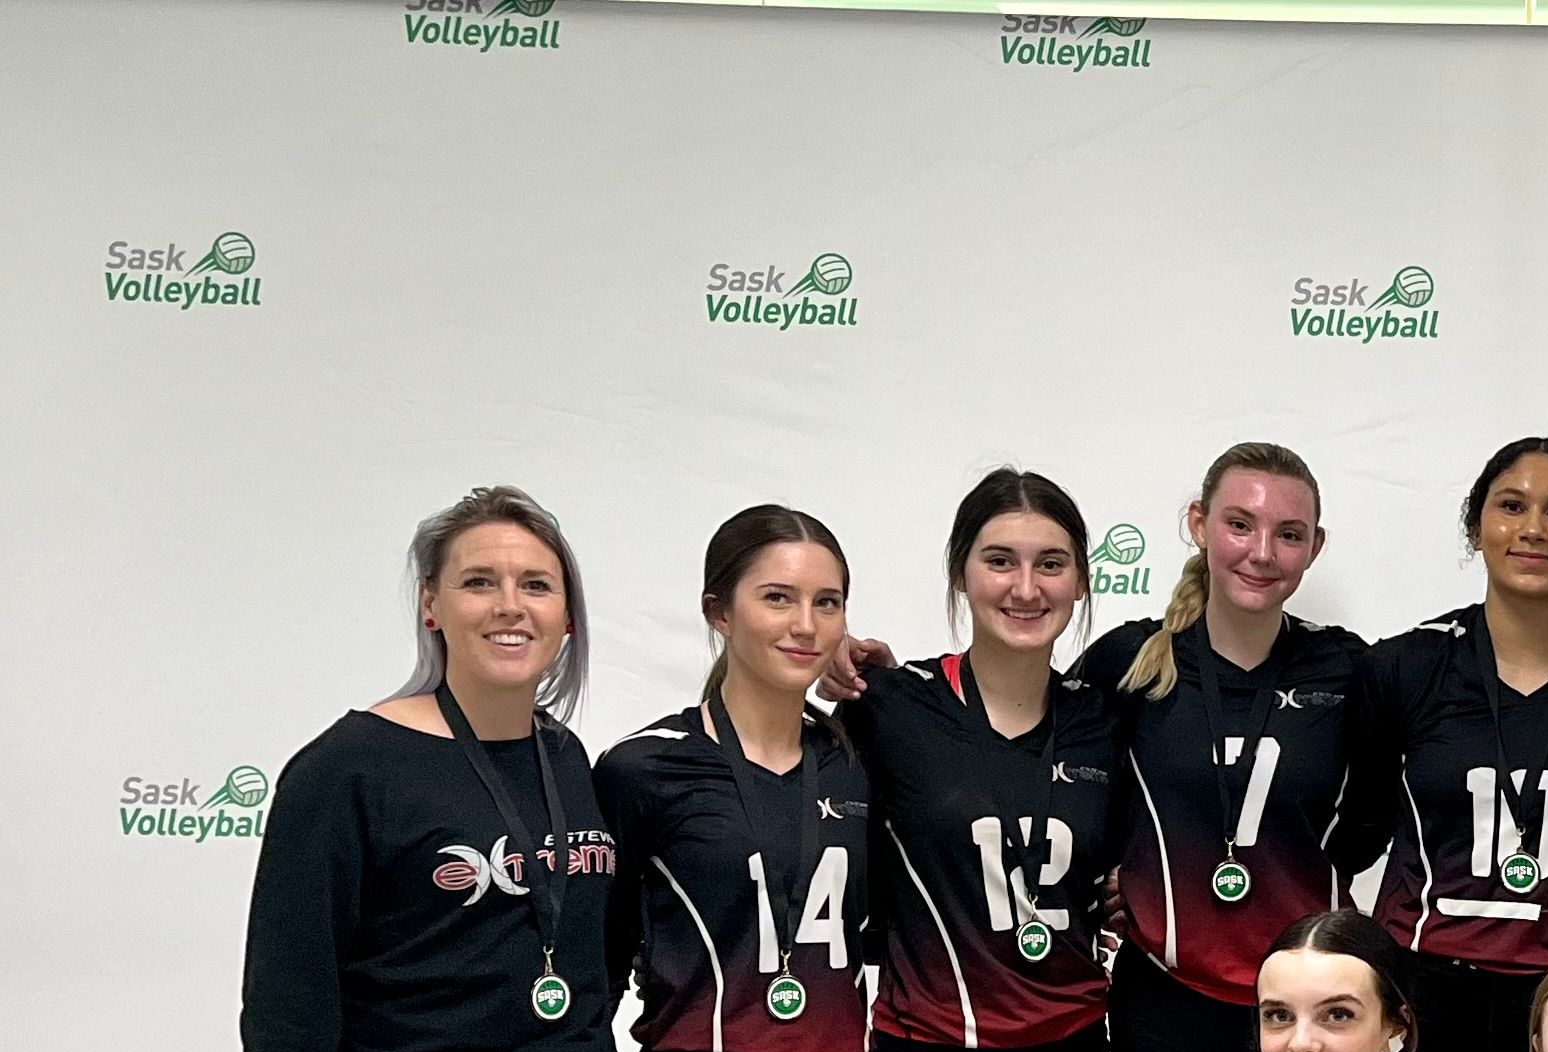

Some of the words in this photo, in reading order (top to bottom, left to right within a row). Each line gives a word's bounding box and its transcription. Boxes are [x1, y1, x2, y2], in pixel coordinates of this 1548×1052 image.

[405, 14, 560, 53] Volleyball
[1001, 36, 1151, 72] Volleyball
[105, 241, 186, 272] Sask
[105, 273, 261, 310] Volleyball
[706, 263, 784, 294] Sask
[1291, 277, 1368, 307] Sask
[706, 295, 858, 331] Volleyball
[1290, 308, 1439, 344] Volleyball
[120, 776, 200, 805] Sask
[1213, 736, 1281, 847] 7
[971, 816, 1072, 931] 12
[748, 846, 848, 973] 14
